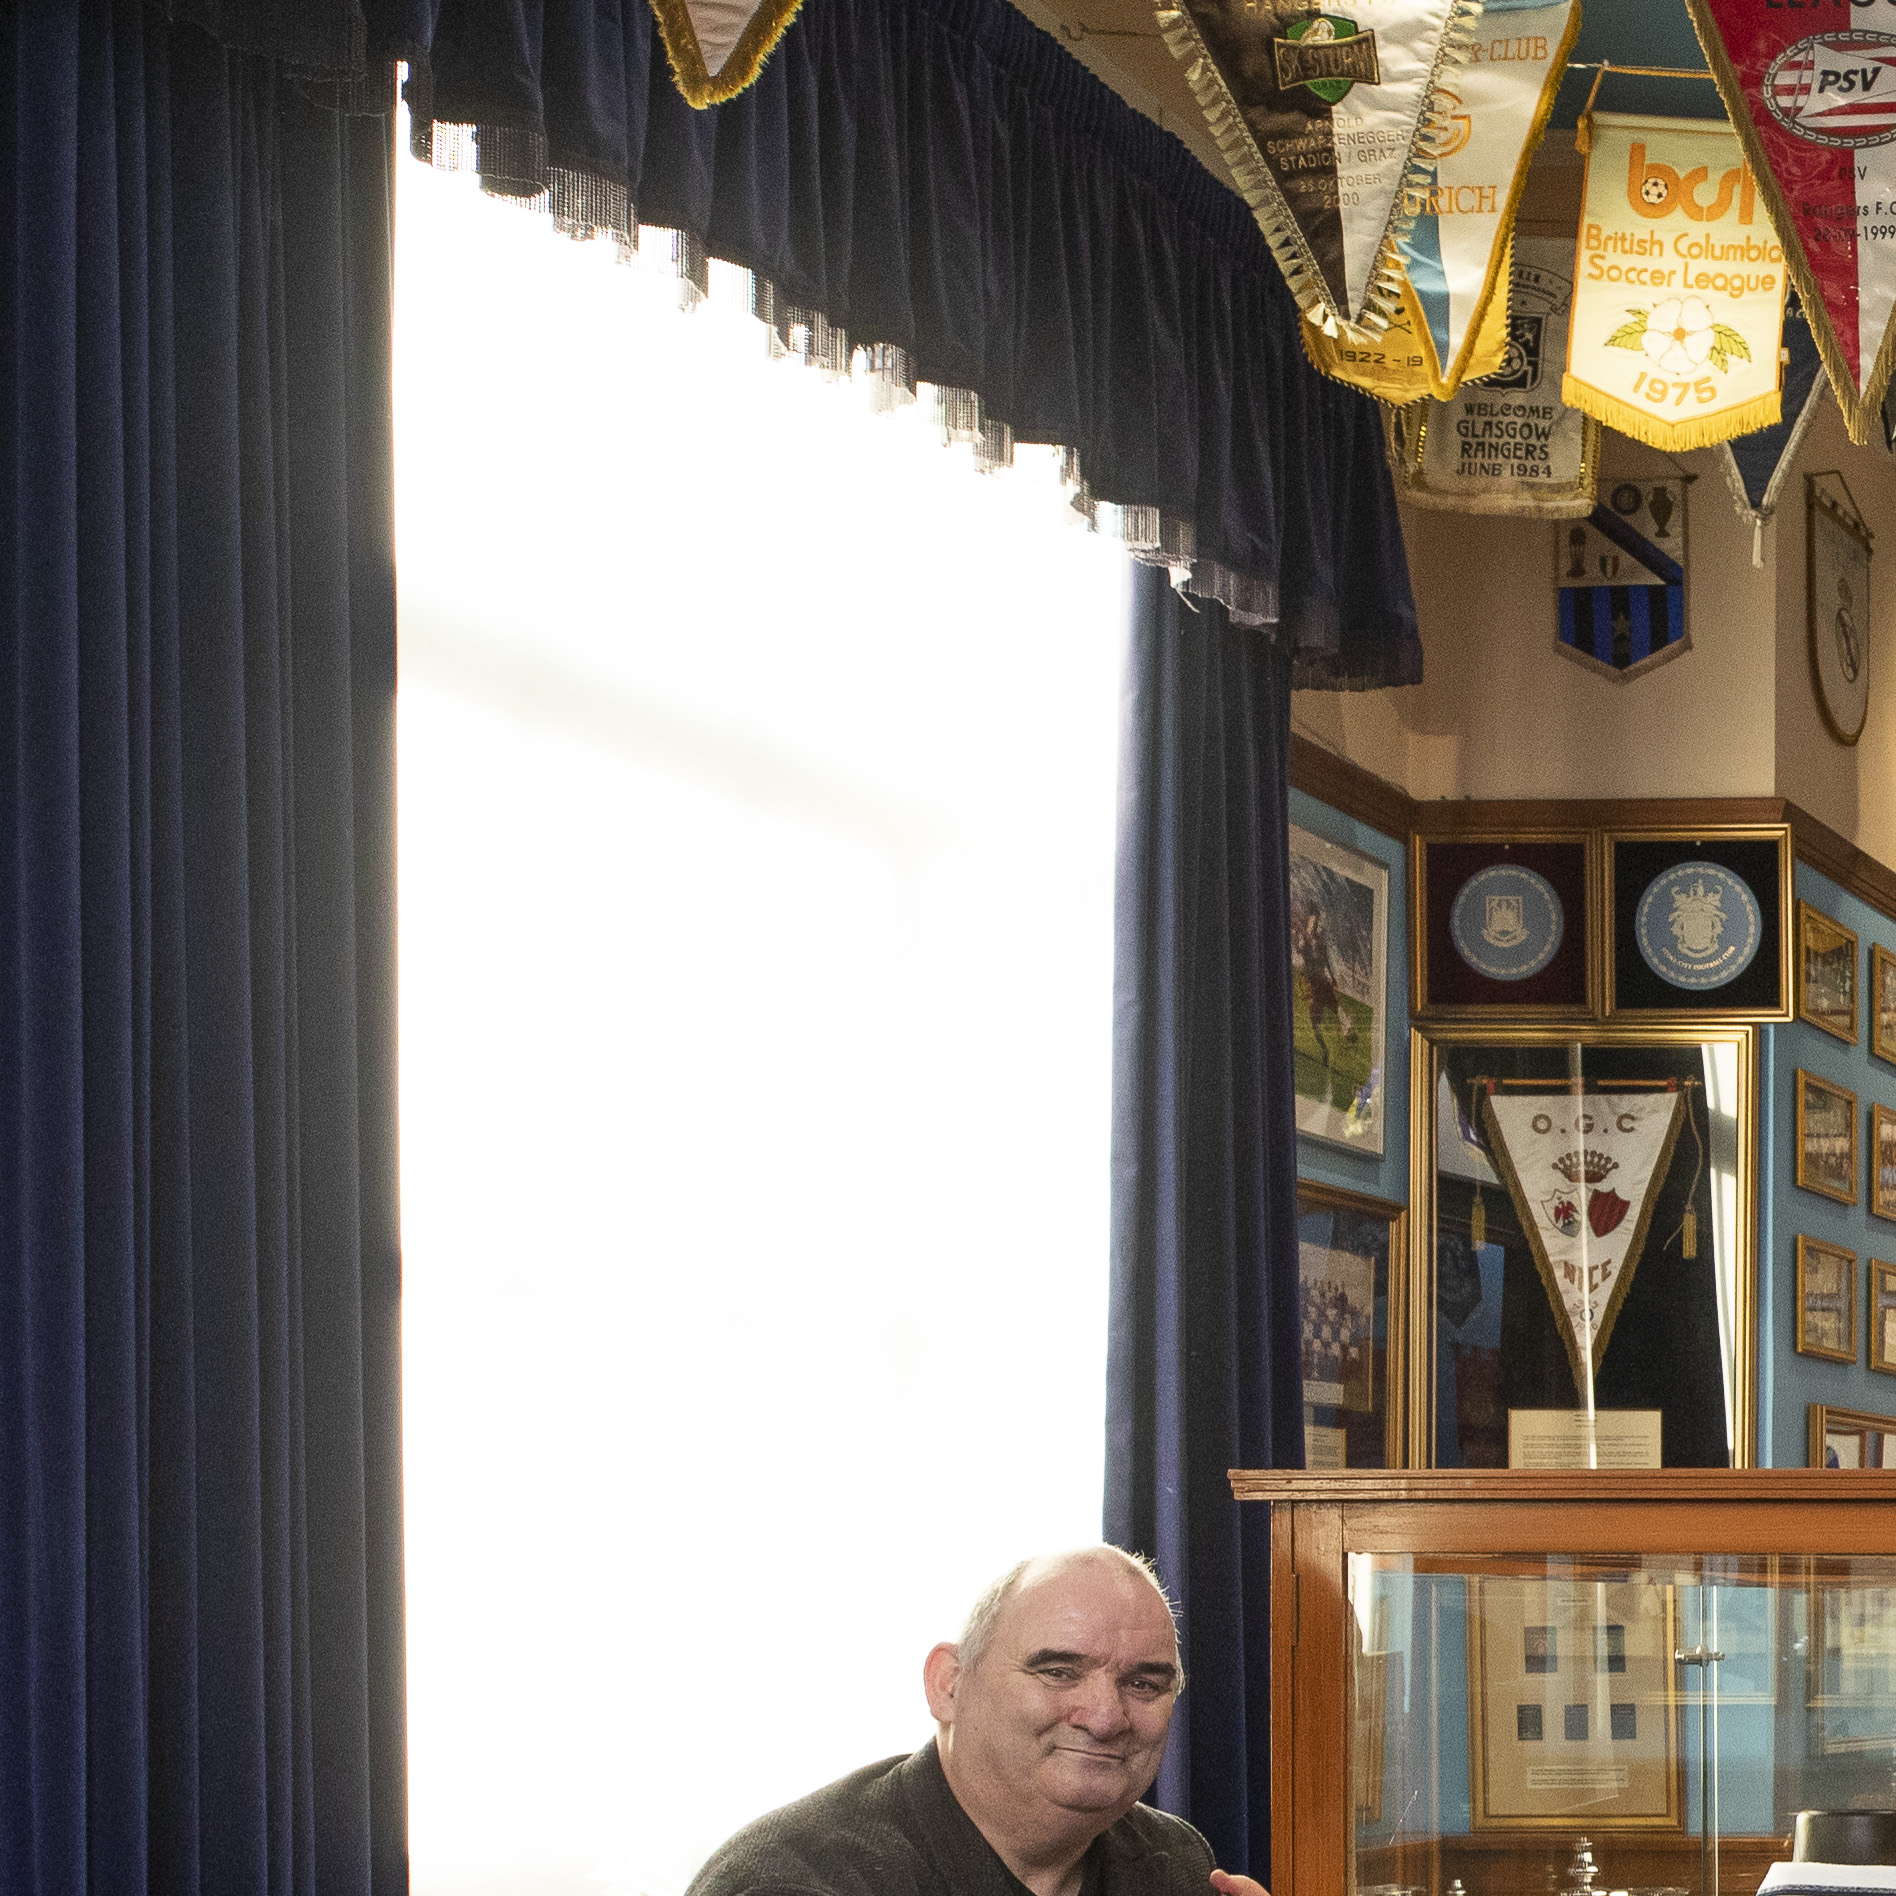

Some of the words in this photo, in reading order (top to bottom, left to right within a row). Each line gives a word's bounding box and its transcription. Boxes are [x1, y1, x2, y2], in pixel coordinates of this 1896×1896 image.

[1818, 67, 1883, 93] PSV
[1587, 224, 1665, 257] British
[1672, 232, 1782, 266] Columbia
[1587, 256, 1676, 286] Soccer
[1683, 265, 1776, 298] League
[1633, 372, 1717, 406] 1975
[1464, 403, 1553, 420] WELCOME
[1456, 420, 1552, 441] GLASGOW
[1461, 443, 1548, 461] RANGERS
[1456, 463, 1505, 478] JUNE
[1510, 463, 1552, 478] 1984
